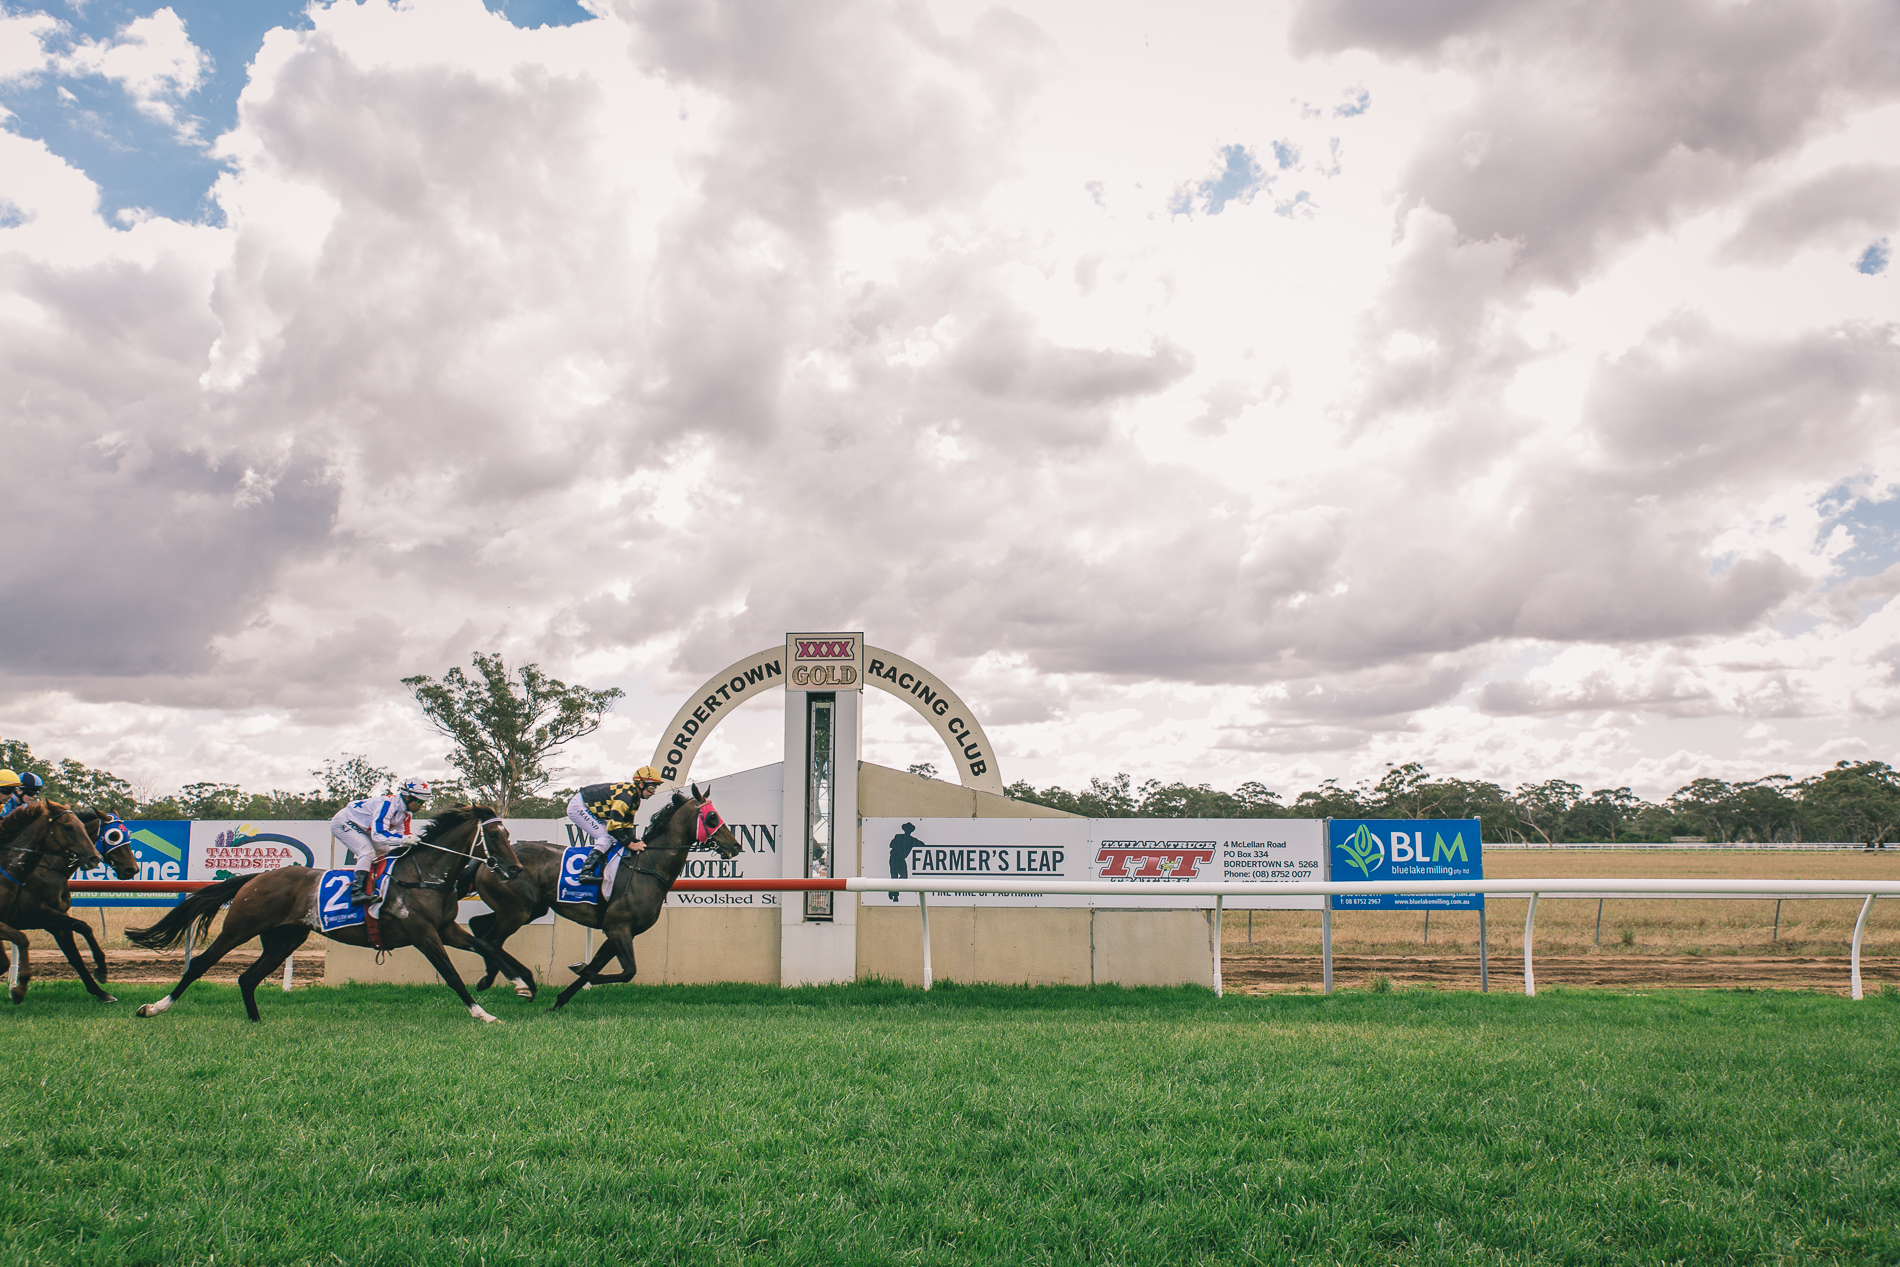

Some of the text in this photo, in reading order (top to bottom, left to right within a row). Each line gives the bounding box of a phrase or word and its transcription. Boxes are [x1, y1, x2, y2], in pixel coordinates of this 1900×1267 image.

[798, 641, 851, 658] XXXX
[792, 665, 857, 686] GOLD
[660, 659, 987, 782] BORDERTOWN RACING CLUB
[206, 847, 292, 858] TATIARA
[1101, 840, 1216, 850] TATIARA TRUCK
[1391, 832, 1468, 862] BLM
[205, 858, 263, 869] SEEDS
[912, 849, 1064, 872] FARMER'S LEAP
[565, 854, 588, 886] 9
[1252, 870, 1269, 879] (08)
[1392, 866, 1408, 874] blue
[1410, 866, 1426, 874] lake
[1426, 866, 1454, 876] milling
[324, 876, 350, 912] 2
[677, 894, 754, 904] Woolshed
[762, 894, 778, 904] St
